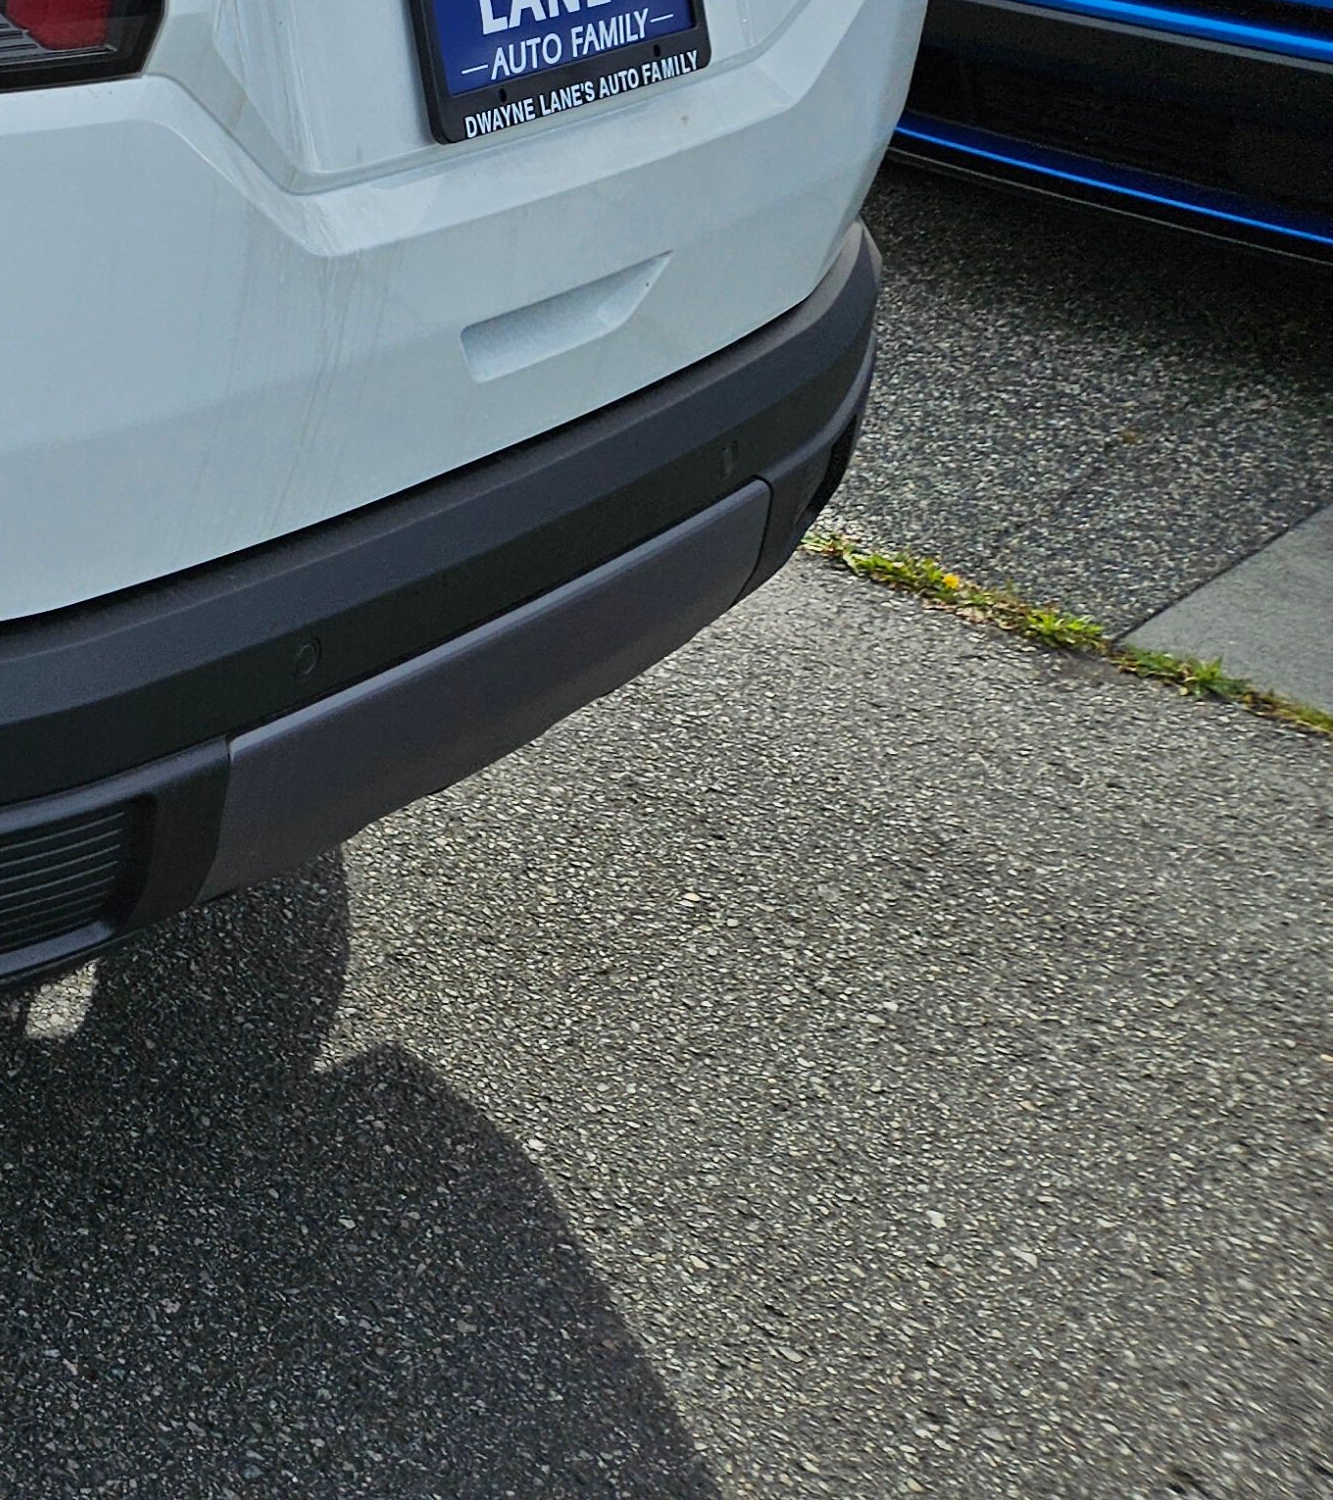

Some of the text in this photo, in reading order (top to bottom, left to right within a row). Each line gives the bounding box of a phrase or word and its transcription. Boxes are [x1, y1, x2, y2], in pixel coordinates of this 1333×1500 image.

[491, 8, 648, 80] AUTO FAMILY
[464, 50, 698, 138] DWAYNE LANE'S AUTO FAMILY
